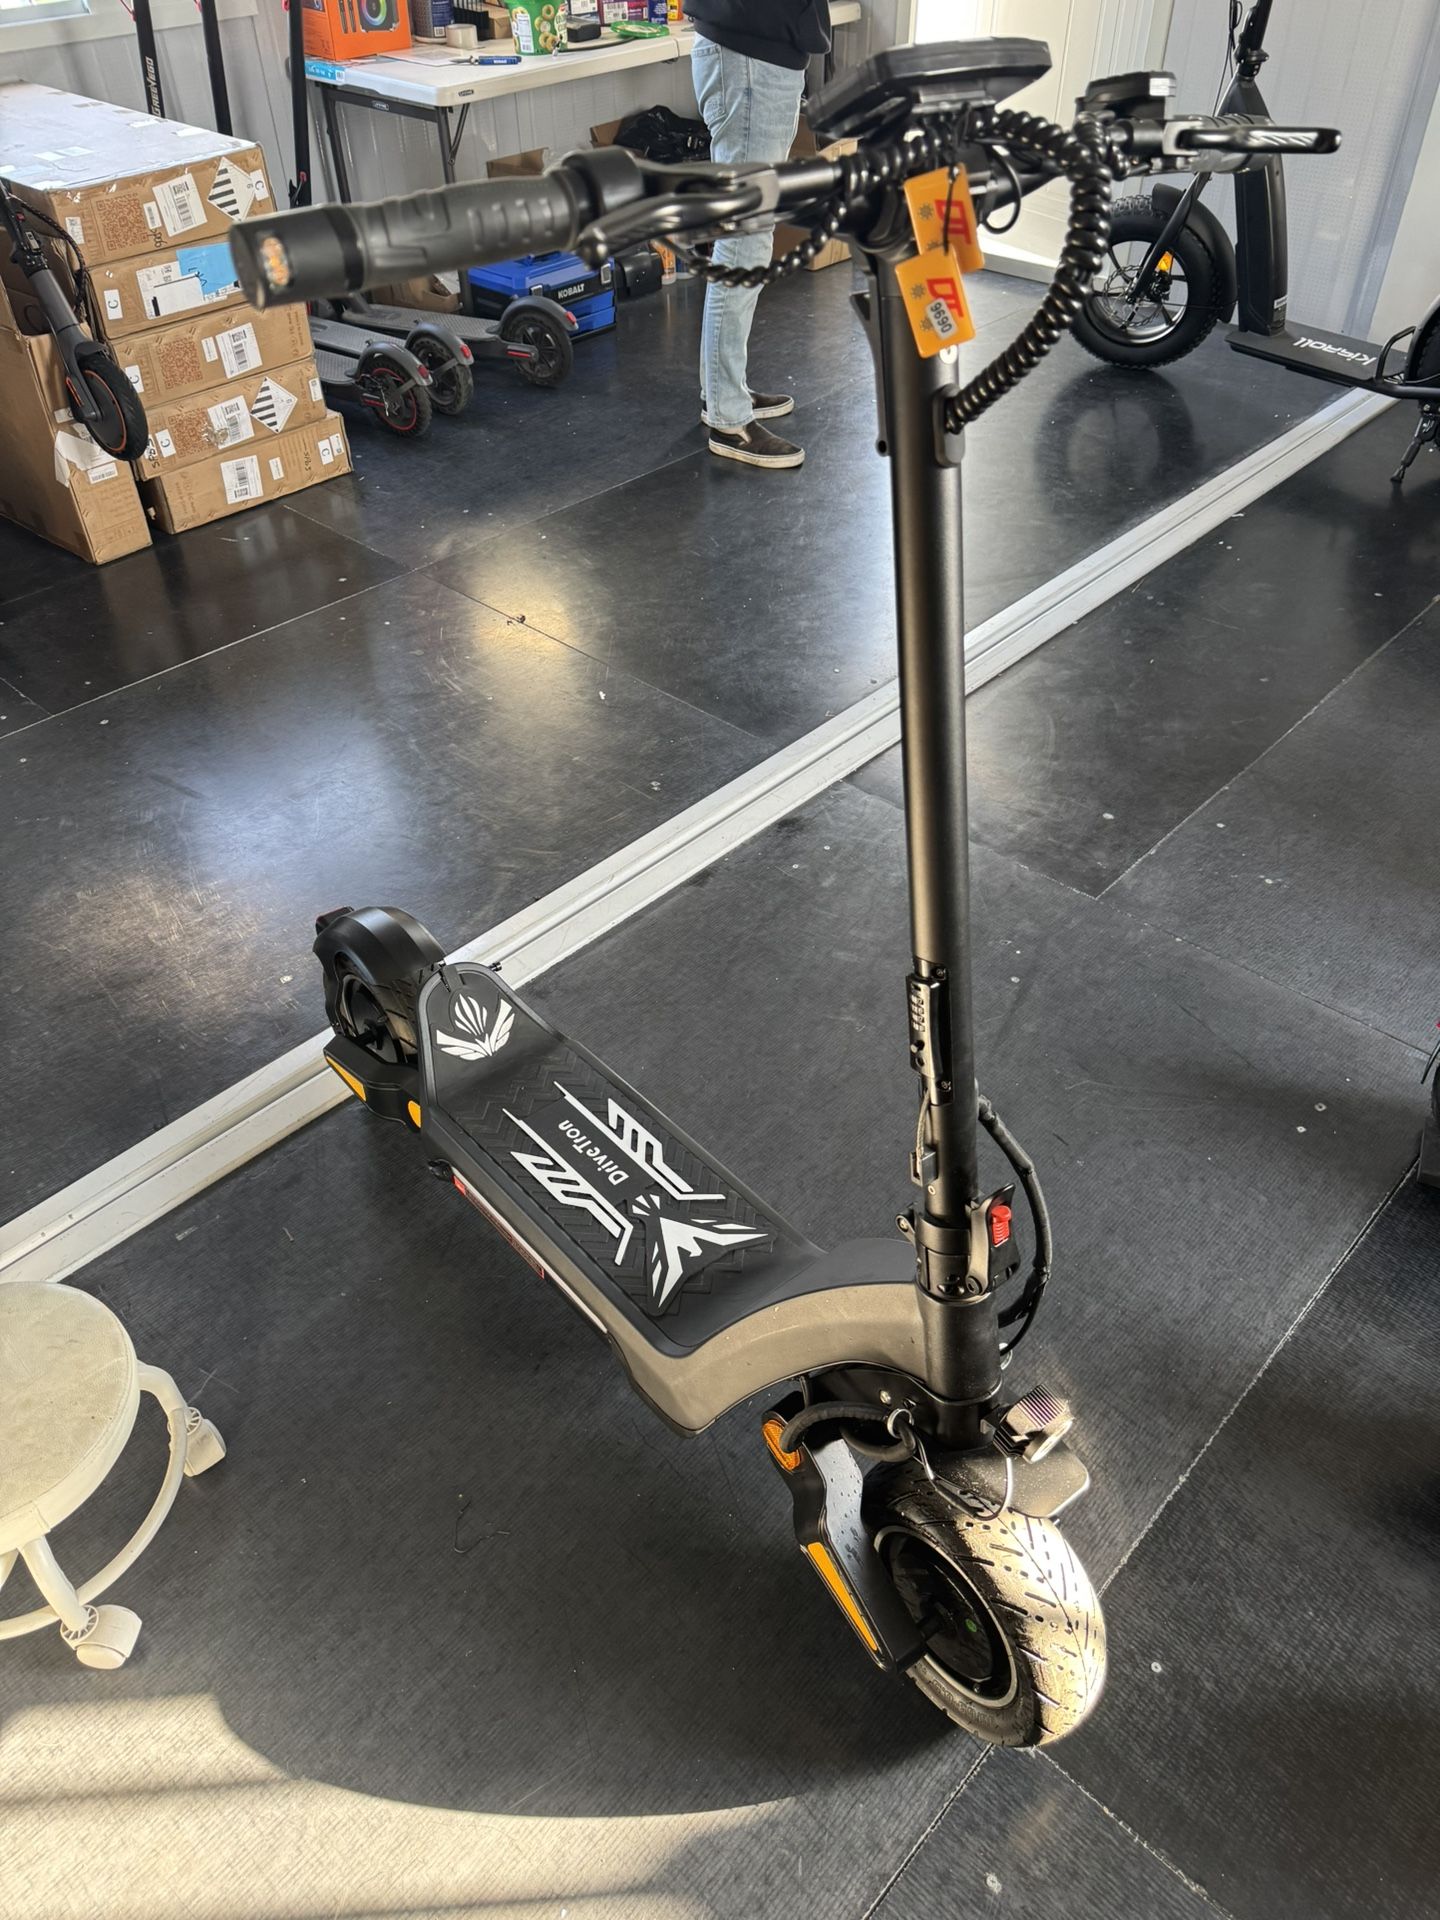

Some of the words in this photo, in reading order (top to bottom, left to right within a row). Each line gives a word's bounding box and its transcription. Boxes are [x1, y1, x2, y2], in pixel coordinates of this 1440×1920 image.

[255, 181, 264, 190] C
[558, 283, 584, 299] KOBALT
[108, 299, 118, 309] C
[160, 439, 171, 447] C
[321, 448, 330, 456] C
[558, 1120, 630, 1186] DriveTron
